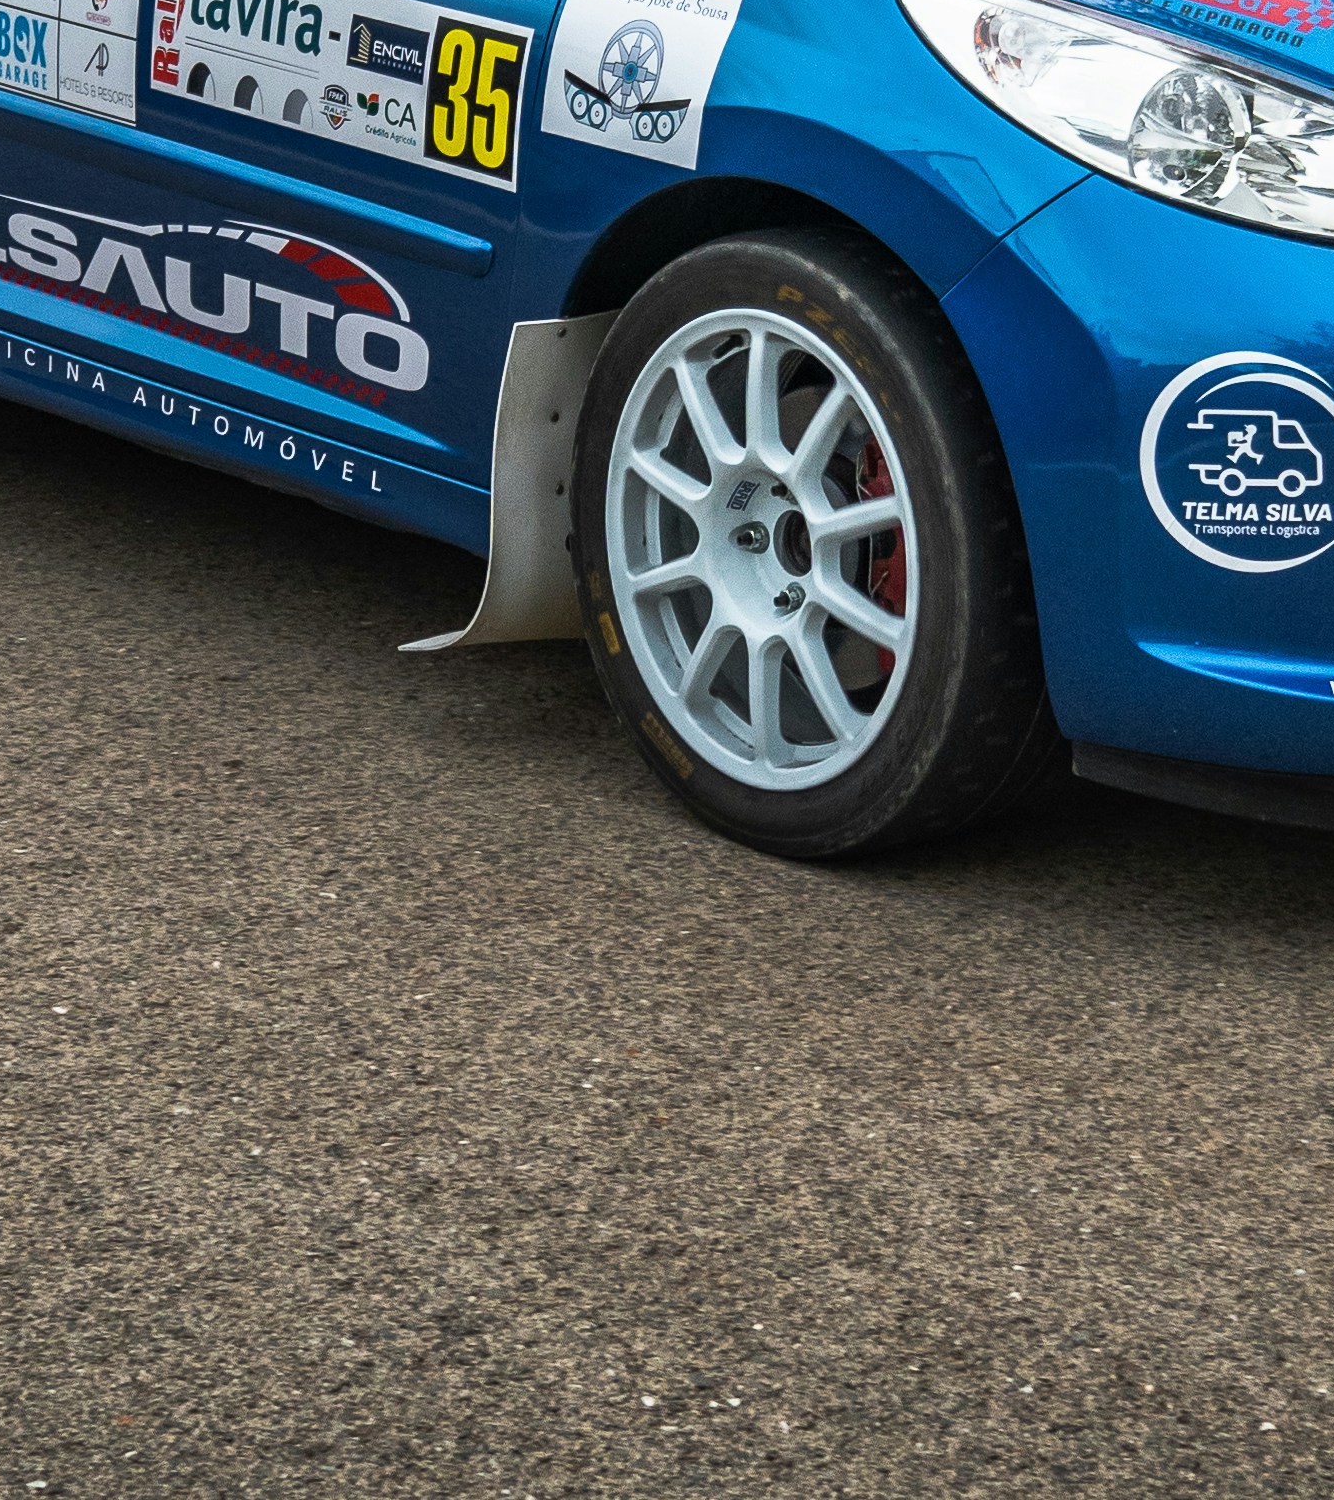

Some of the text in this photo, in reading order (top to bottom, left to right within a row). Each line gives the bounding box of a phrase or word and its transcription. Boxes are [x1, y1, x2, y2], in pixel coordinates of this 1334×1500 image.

[372, 40, 423, 66] ENCIVIL
[60, 76, 90, 97] HOTELS
[97, 86, 134, 109] RESORTS
[432, 28, 519, 170] 35
[323, 104, 348, 117] RALIS
[385, 98, 416, 131] CA
[133, 386, 382, 492] AUTOMÓVEL
[1182, 502, 1333, 521] TELMA SILVA
[1194, 523, 1257, 537] Transporte
[1260, 525, 1267, 535] e
